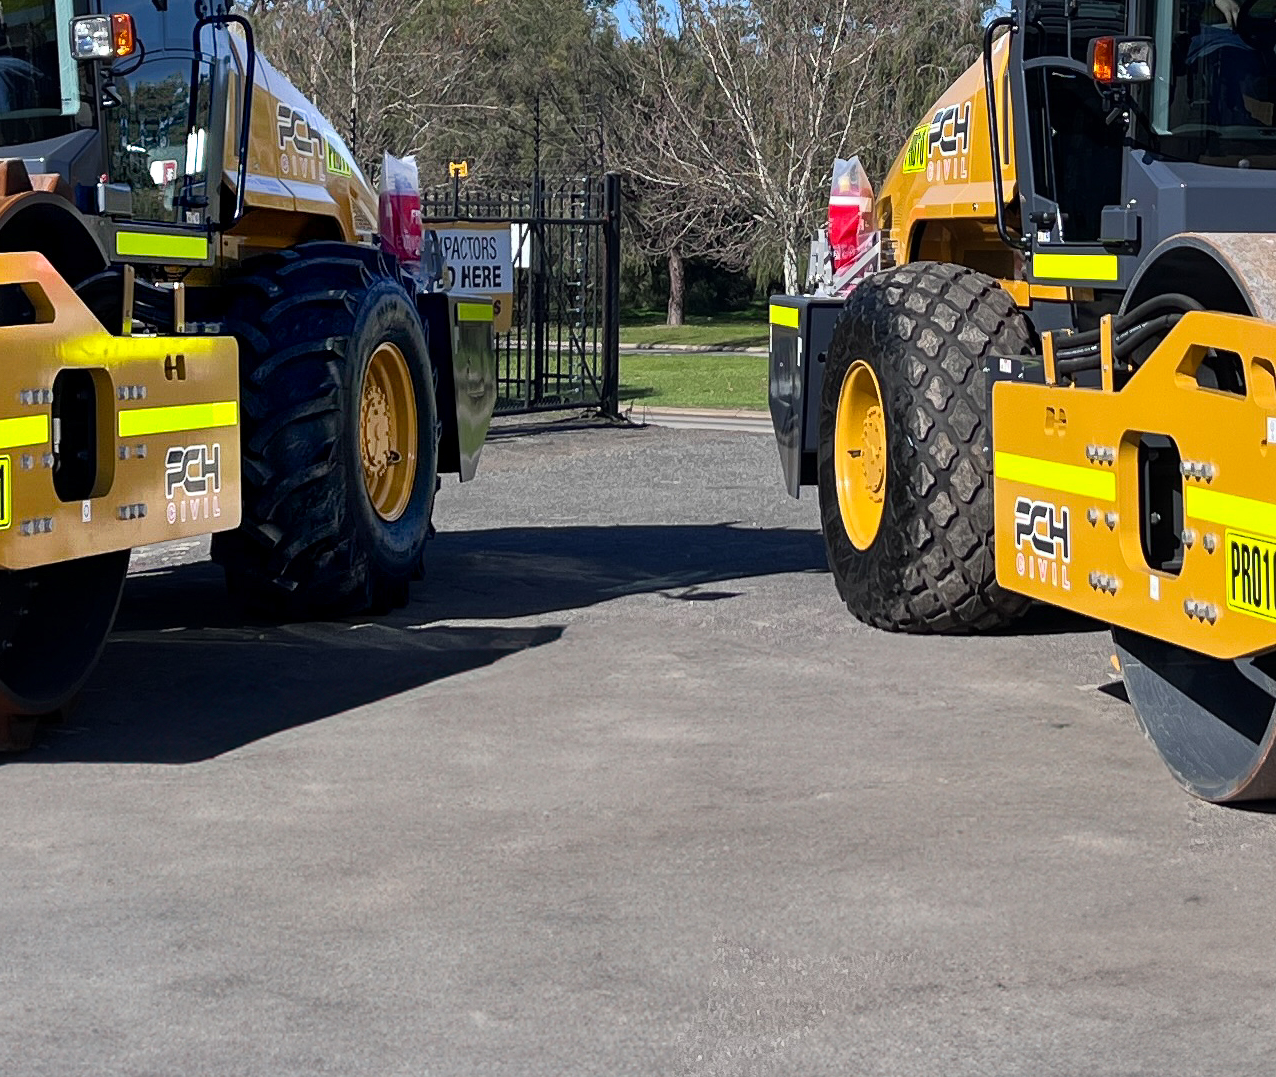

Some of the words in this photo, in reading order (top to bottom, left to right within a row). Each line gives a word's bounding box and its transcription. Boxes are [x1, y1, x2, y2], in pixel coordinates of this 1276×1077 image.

[928, 101, 971, 158] PCH
[280, 154, 326, 181] CIVIL
[927, 156, 968, 182] CIVIL
[439, 236, 497, 260] PACTORS
[461, 265, 501, 288] HERE
[165, 443, 220, 499] PCH
[166, 496, 221, 524] CIVIL
[1015, 496, 1070, 563] PCH
[1016, 552, 1070, 591] CIVIL
